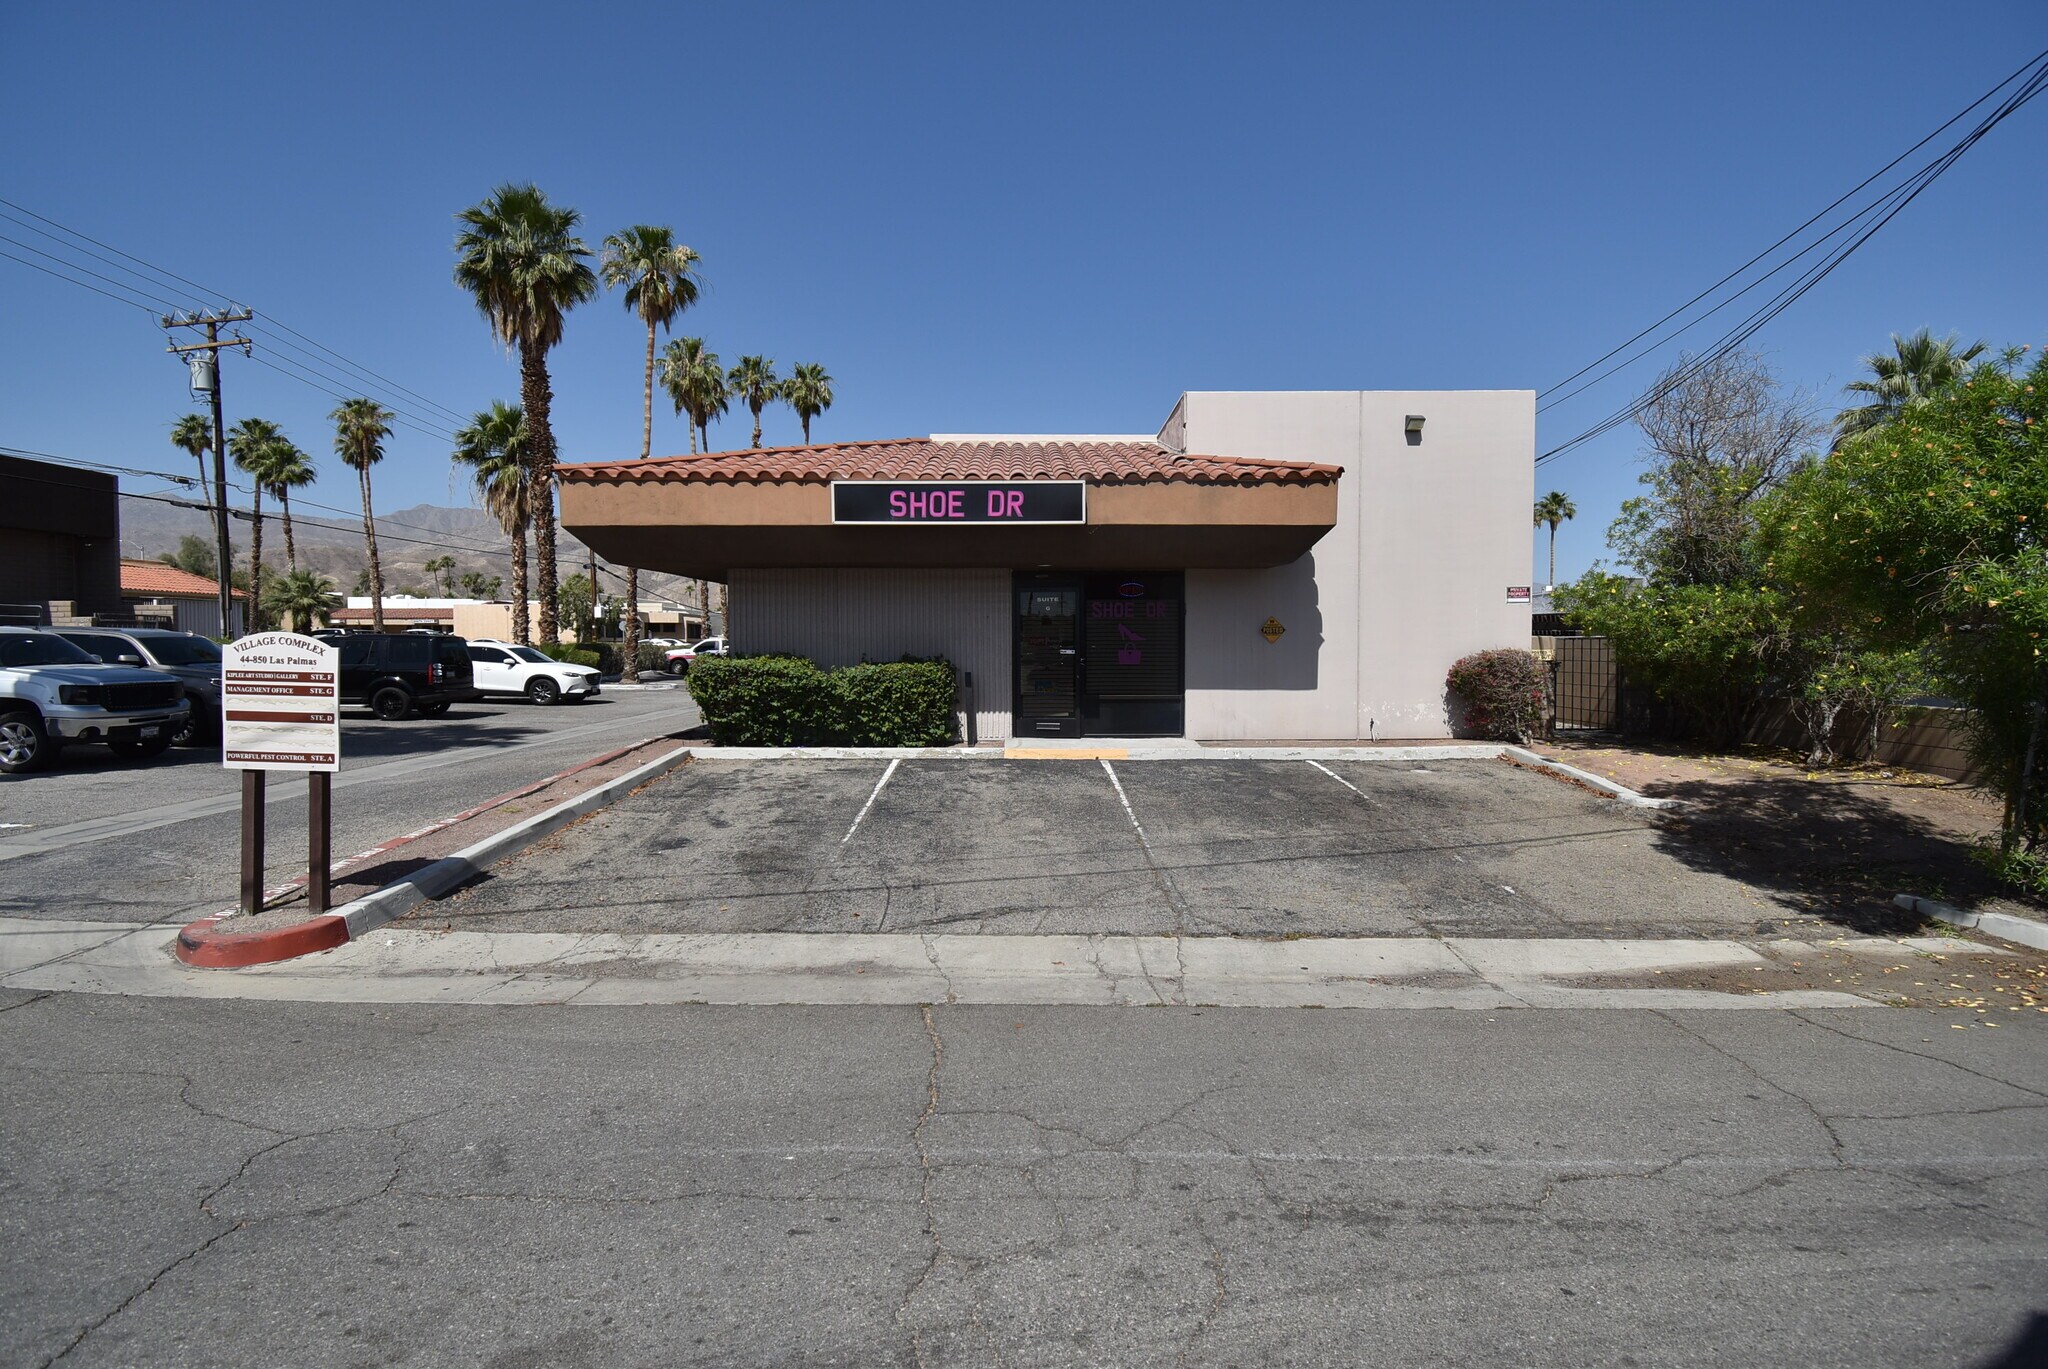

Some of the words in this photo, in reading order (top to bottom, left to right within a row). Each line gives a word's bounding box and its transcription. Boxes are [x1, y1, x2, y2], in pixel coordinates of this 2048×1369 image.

[889, 490, 965, 518] SHOE
[987, 490, 1024, 517] DR
[1091, 602, 1135, 618] SHOE
[1146, 602, 1166, 618] DR
[233, 636, 276, 653] VILLAGE
[278, 637, 326, 656] COMPLEX
[240, 655, 267, 664] 44-850
[269, 656, 284, 665] Las
[287, 656, 317, 666] Palmas
[227, 752, 261, 760] POWERFUL
